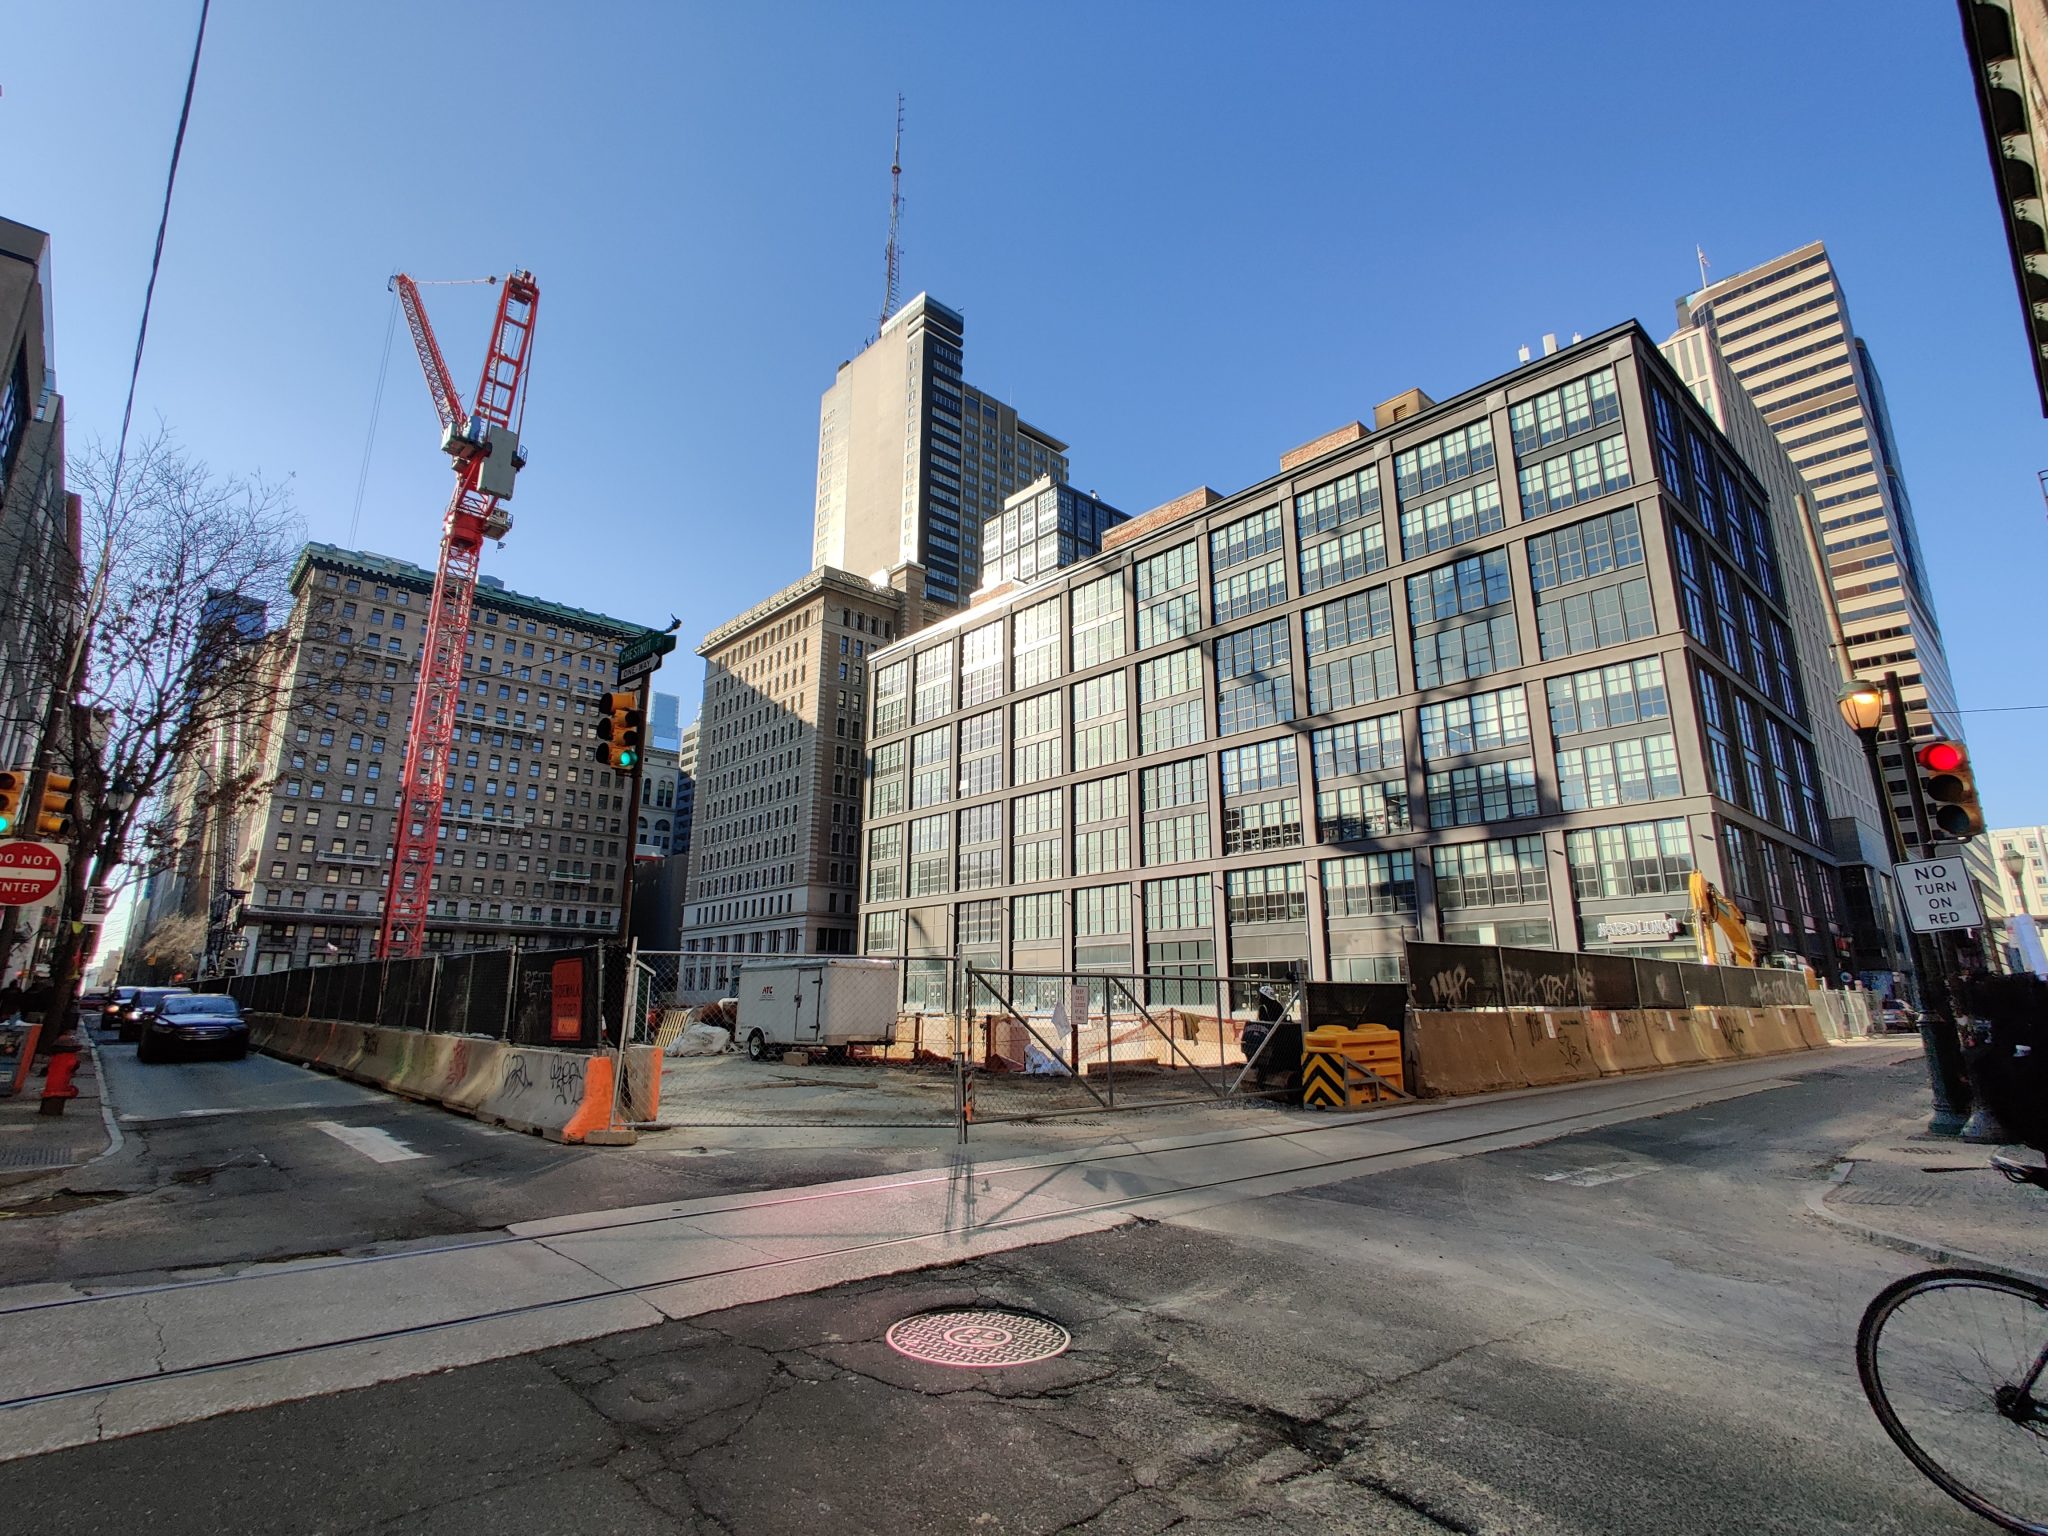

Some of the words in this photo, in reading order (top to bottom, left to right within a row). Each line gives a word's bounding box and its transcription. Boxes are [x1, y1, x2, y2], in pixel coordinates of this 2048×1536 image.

[621, 639, 652, 663] CHESTNUT
[623, 667, 636, 678] ONE
[638, 660, 651, 671] WAY
[21, 855, 53, 866] NOT
[1914, 865, 1946, 881] NO
[0, 881, 41, 893] NTER
[1914, 881, 1957, 896] TURN
[1929, 897, 1952, 909] ON
[1929, 911, 1960, 925] RED
[1597, 922, 1637, 938] NAKED
[1638, 918, 1679, 935] LUNCH
